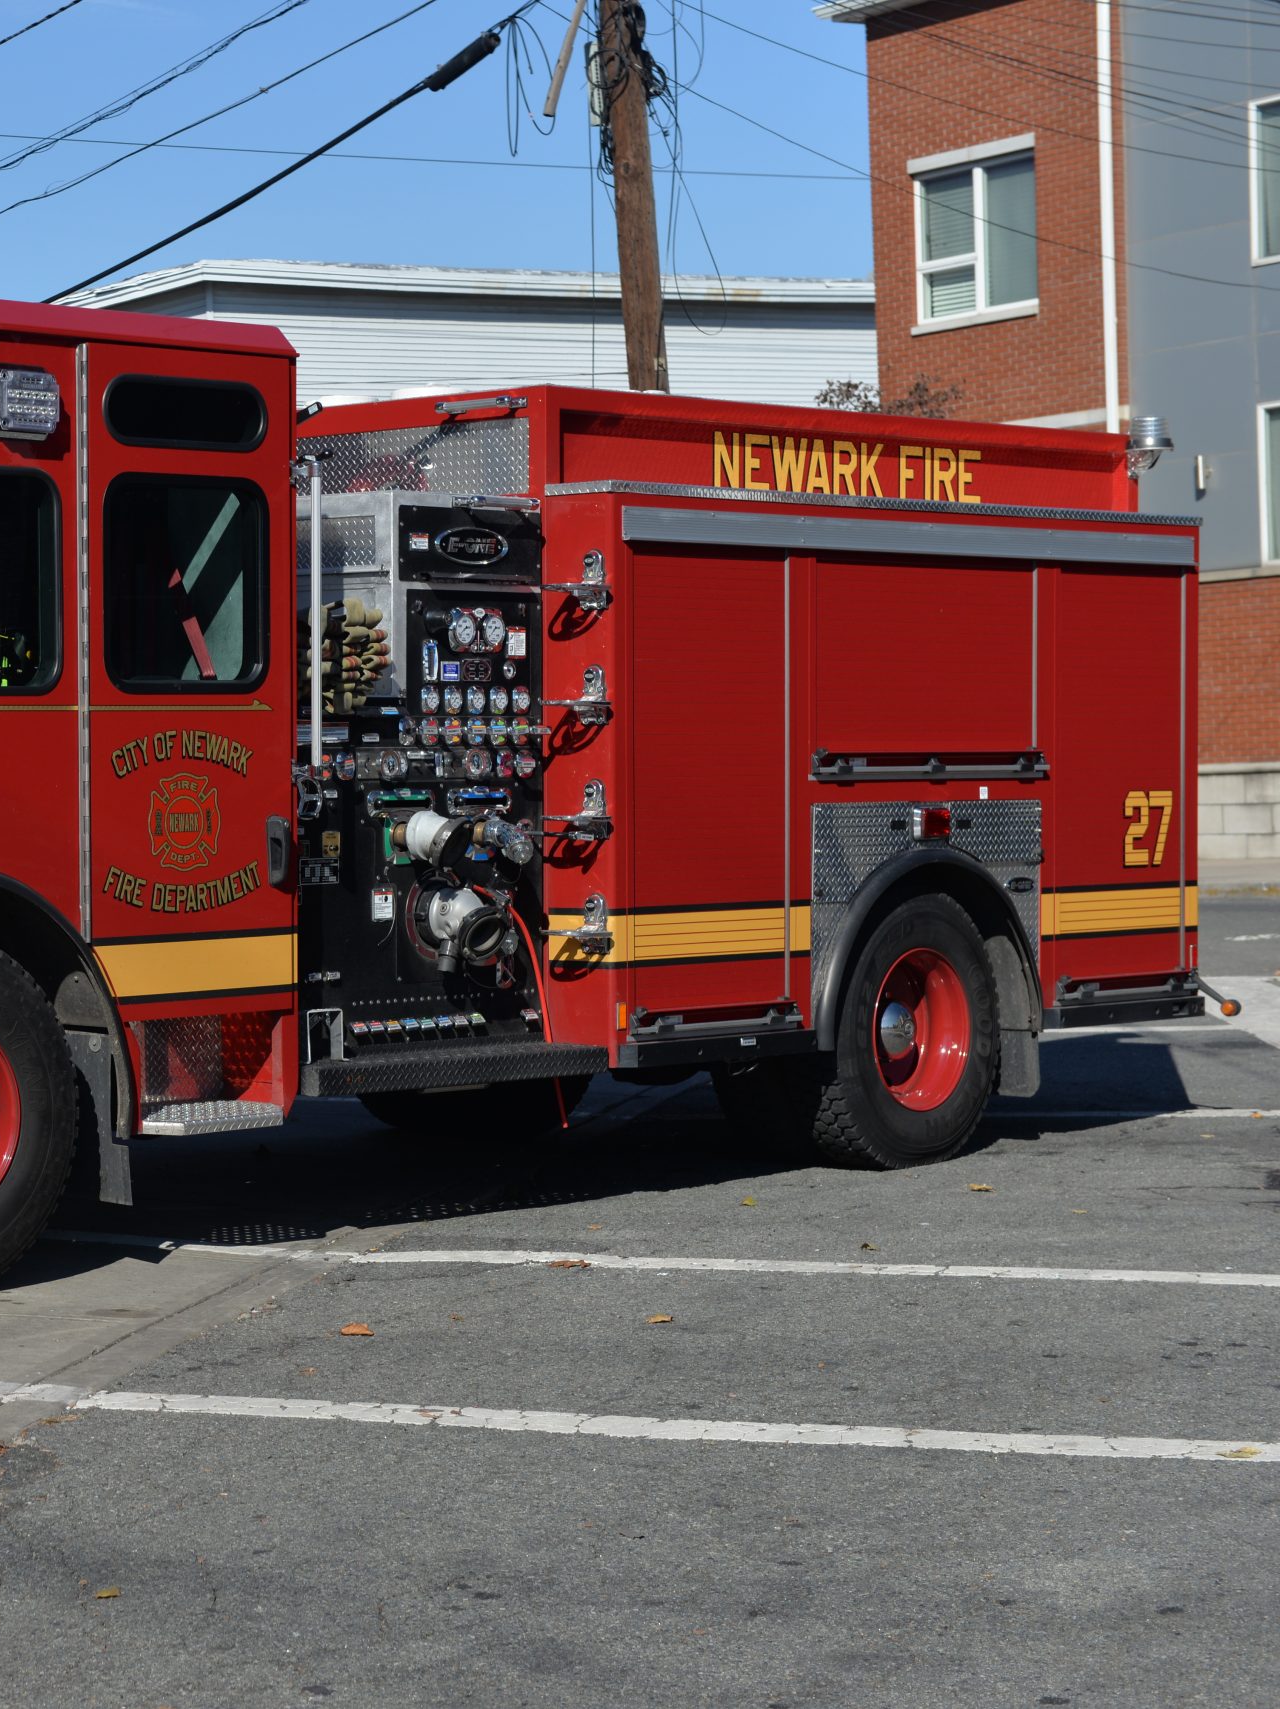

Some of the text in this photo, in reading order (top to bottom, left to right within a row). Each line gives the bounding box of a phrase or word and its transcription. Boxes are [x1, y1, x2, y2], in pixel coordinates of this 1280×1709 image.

[713, 431, 981, 504] NEWARK FIRE
[111, 736, 149, 778] CITY
[153, 730, 177, 761] OF
[181, 730, 253, 778] NEWARK
[170, 780, 198, 792] FIRE
[169, 813, 199, 833] NEWARK
[1123, 790, 1173, 868] 27
[103, 865, 147, 907] FIRE
[151, 860, 261, 913] DEPARTMENT
